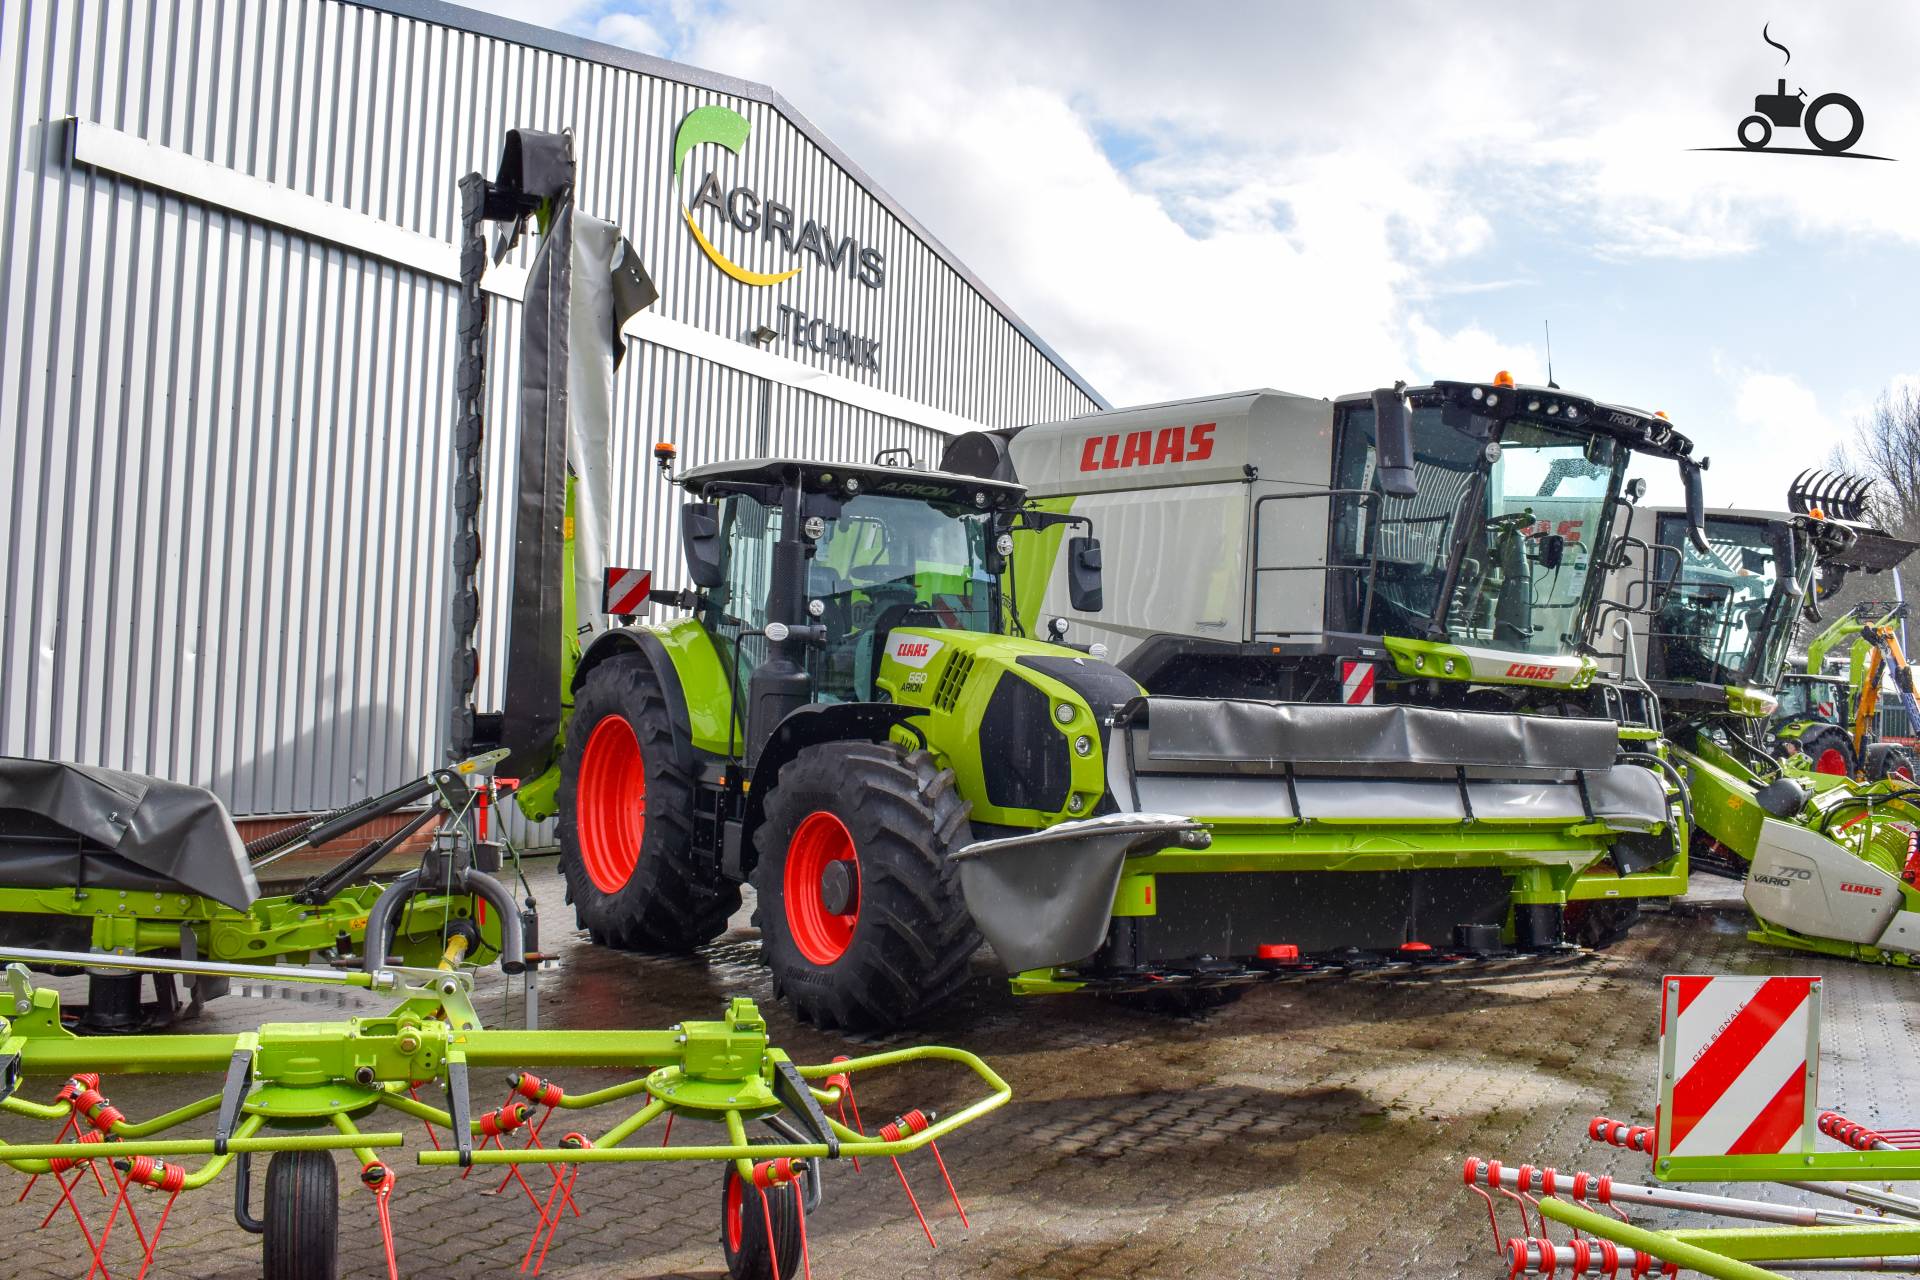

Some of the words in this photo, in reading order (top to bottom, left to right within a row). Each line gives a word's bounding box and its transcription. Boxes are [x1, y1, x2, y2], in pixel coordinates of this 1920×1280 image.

[692, 169, 885, 289] AGRAVIS
[777, 303, 880, 374] TECHNIK
[1608, 411, 1641, 428] TRION
[1080, 422, 1217, 472] CLAAS
[877, 482, 957, 497] ARION
[897, 643, 929, 657] CLAAS
[908, 671, 928, 684] 660
[1505, 662, 1559, 681] CLAAS
[901, 682, 923, 693] ARION
[1753, 874, 1791, 888] VARIO
[1778, 866, 1812, 881] 770
[1840, 881, 1883, 897] CLAAS
[1692, 1042, 1711, 1063] CFG
[1710, 1001, 1746, 1042] SGNALE
